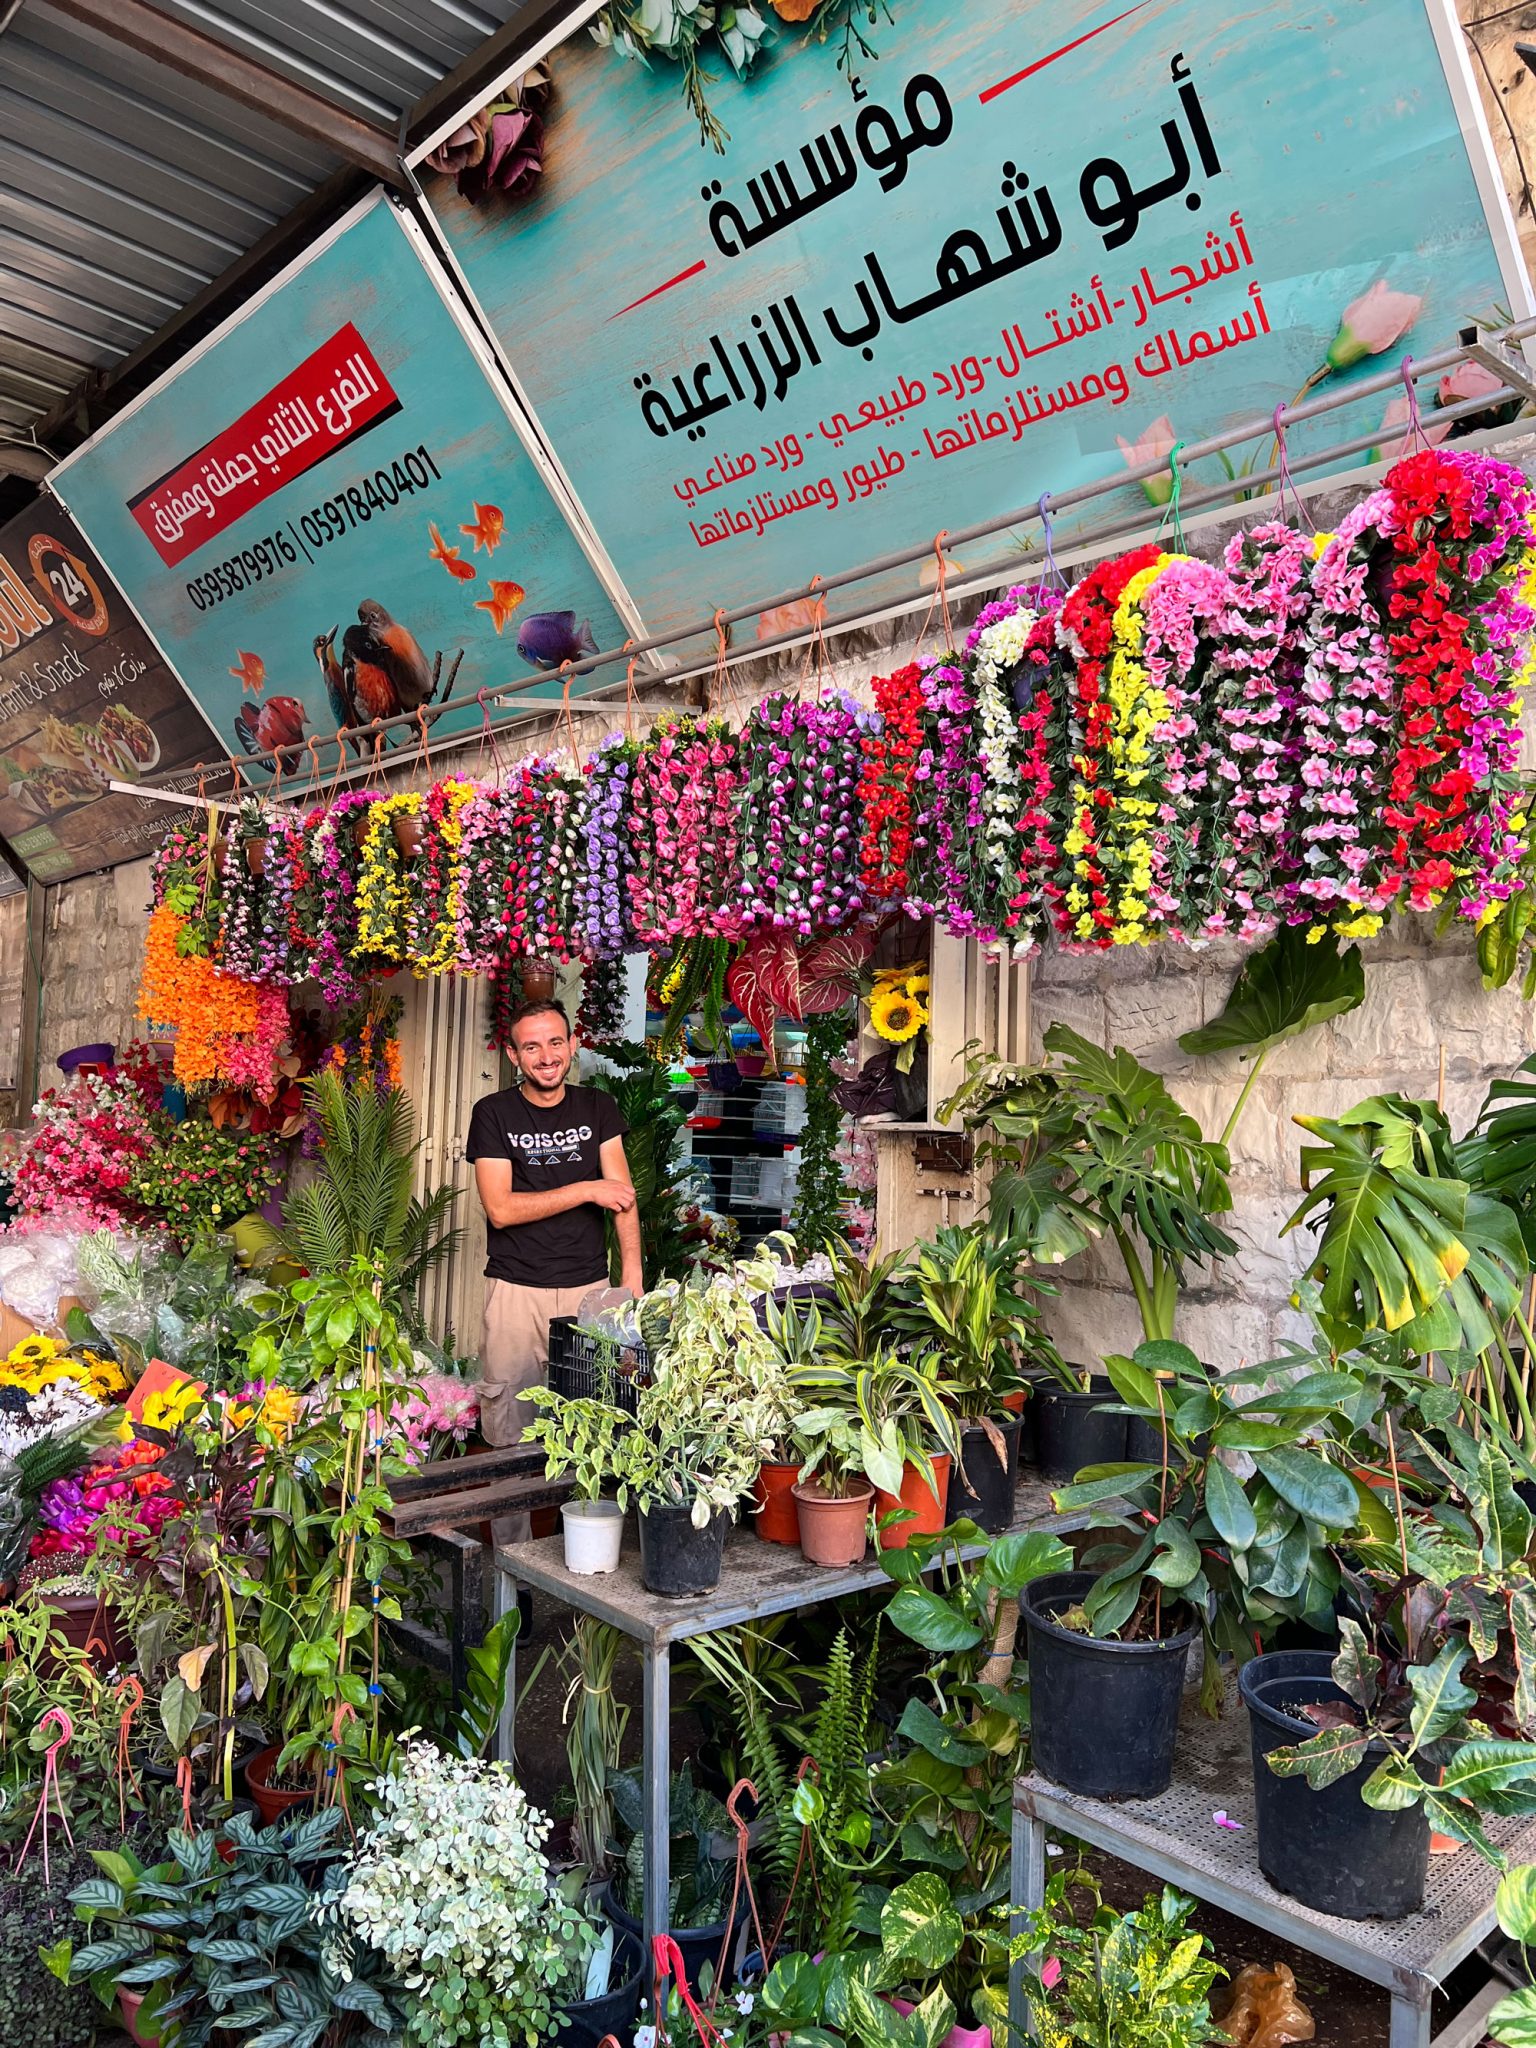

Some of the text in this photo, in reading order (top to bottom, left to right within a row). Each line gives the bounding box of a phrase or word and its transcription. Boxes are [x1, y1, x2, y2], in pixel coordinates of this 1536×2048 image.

[701, 74, 953, 258] مؤسسة
[633, 52, 1222, 442] أبو شهاب الزراعية
[1133, 281, 1271, 379] أسماك
[818, 376, 927, 449] طبيعي
[923, 364, 1130, 460] ومستلزماتها
[149, 352, 380, 544] الفرع الثاني جملة ومفرق
[673, 452, 757, 508] صناعي
[760, 434, 804, 472] ورد
[842, 447, 906, 503] طيور
[185, 529, 298, 612] 0595879976
[300, 444, 442, 548] 0597840401
[688, 477, 839, 547] ومستلزماتها
[49, 561, 88, 606] 24
[20, 670, 48, 700] &
[33, 642, 91, 693] Snack
